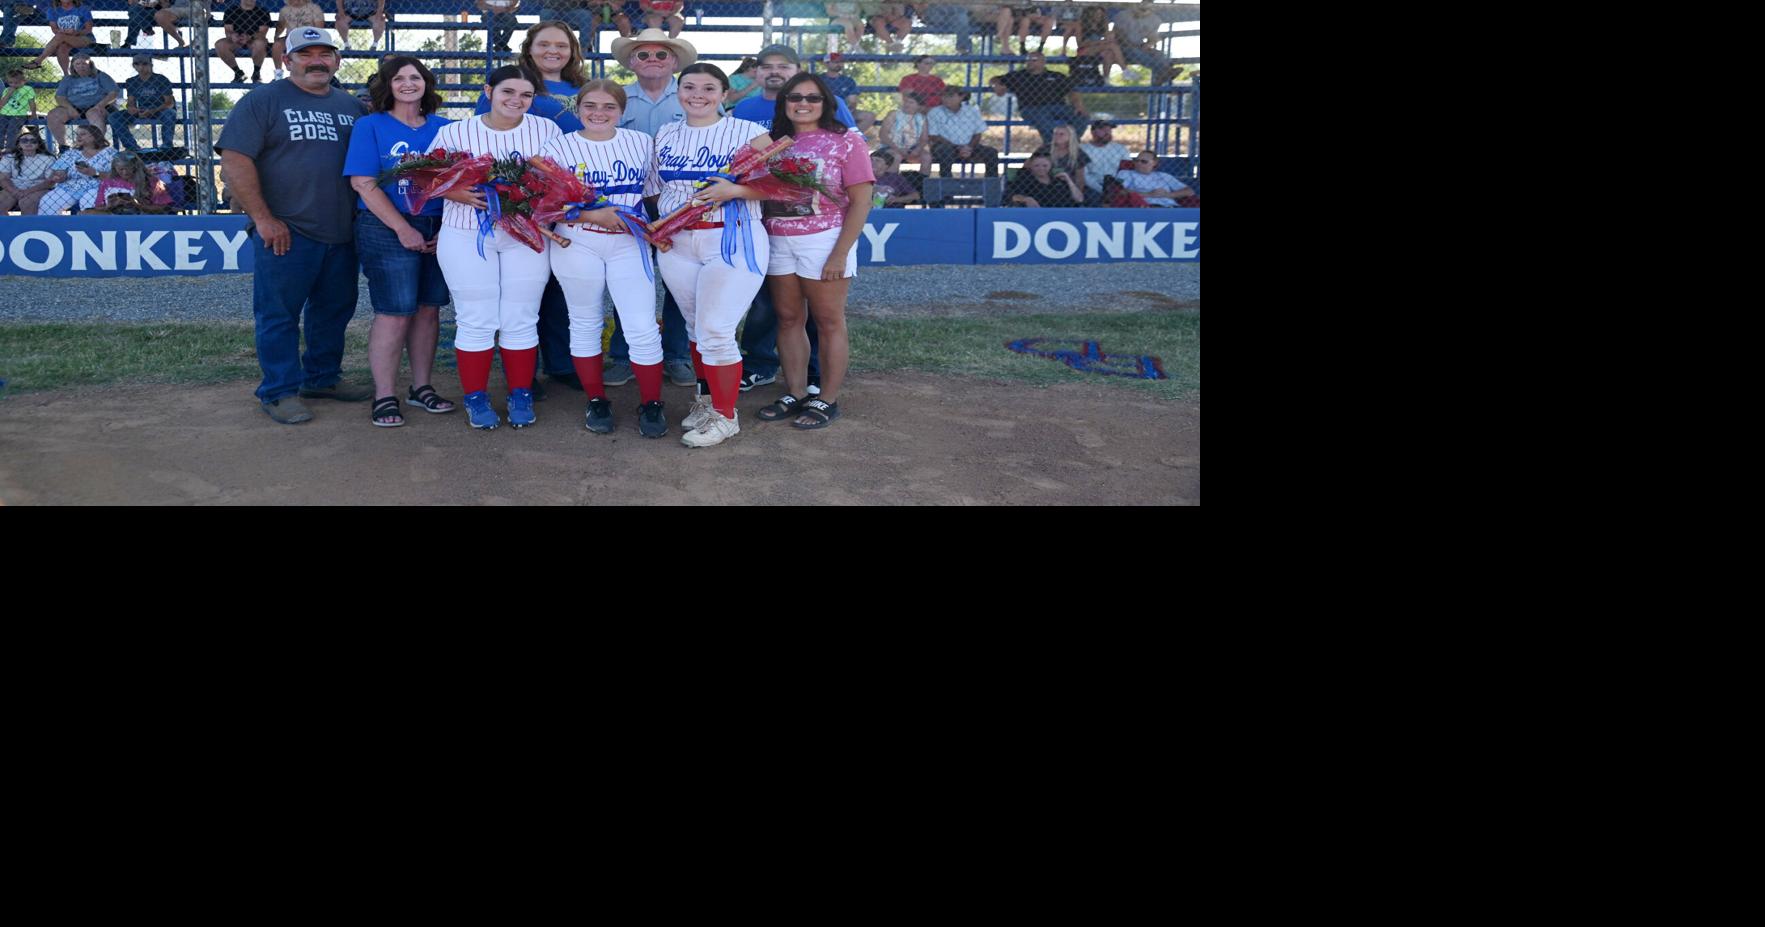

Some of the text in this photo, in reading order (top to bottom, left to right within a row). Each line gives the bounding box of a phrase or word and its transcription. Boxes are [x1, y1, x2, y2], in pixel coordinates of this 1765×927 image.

[284, 109, 355, 126] CLASS OF
[289, 123, 338, 141] 2025
[0, 230, 250, 272] ONKEY
[992, 220, 1200, 260] DONKE
